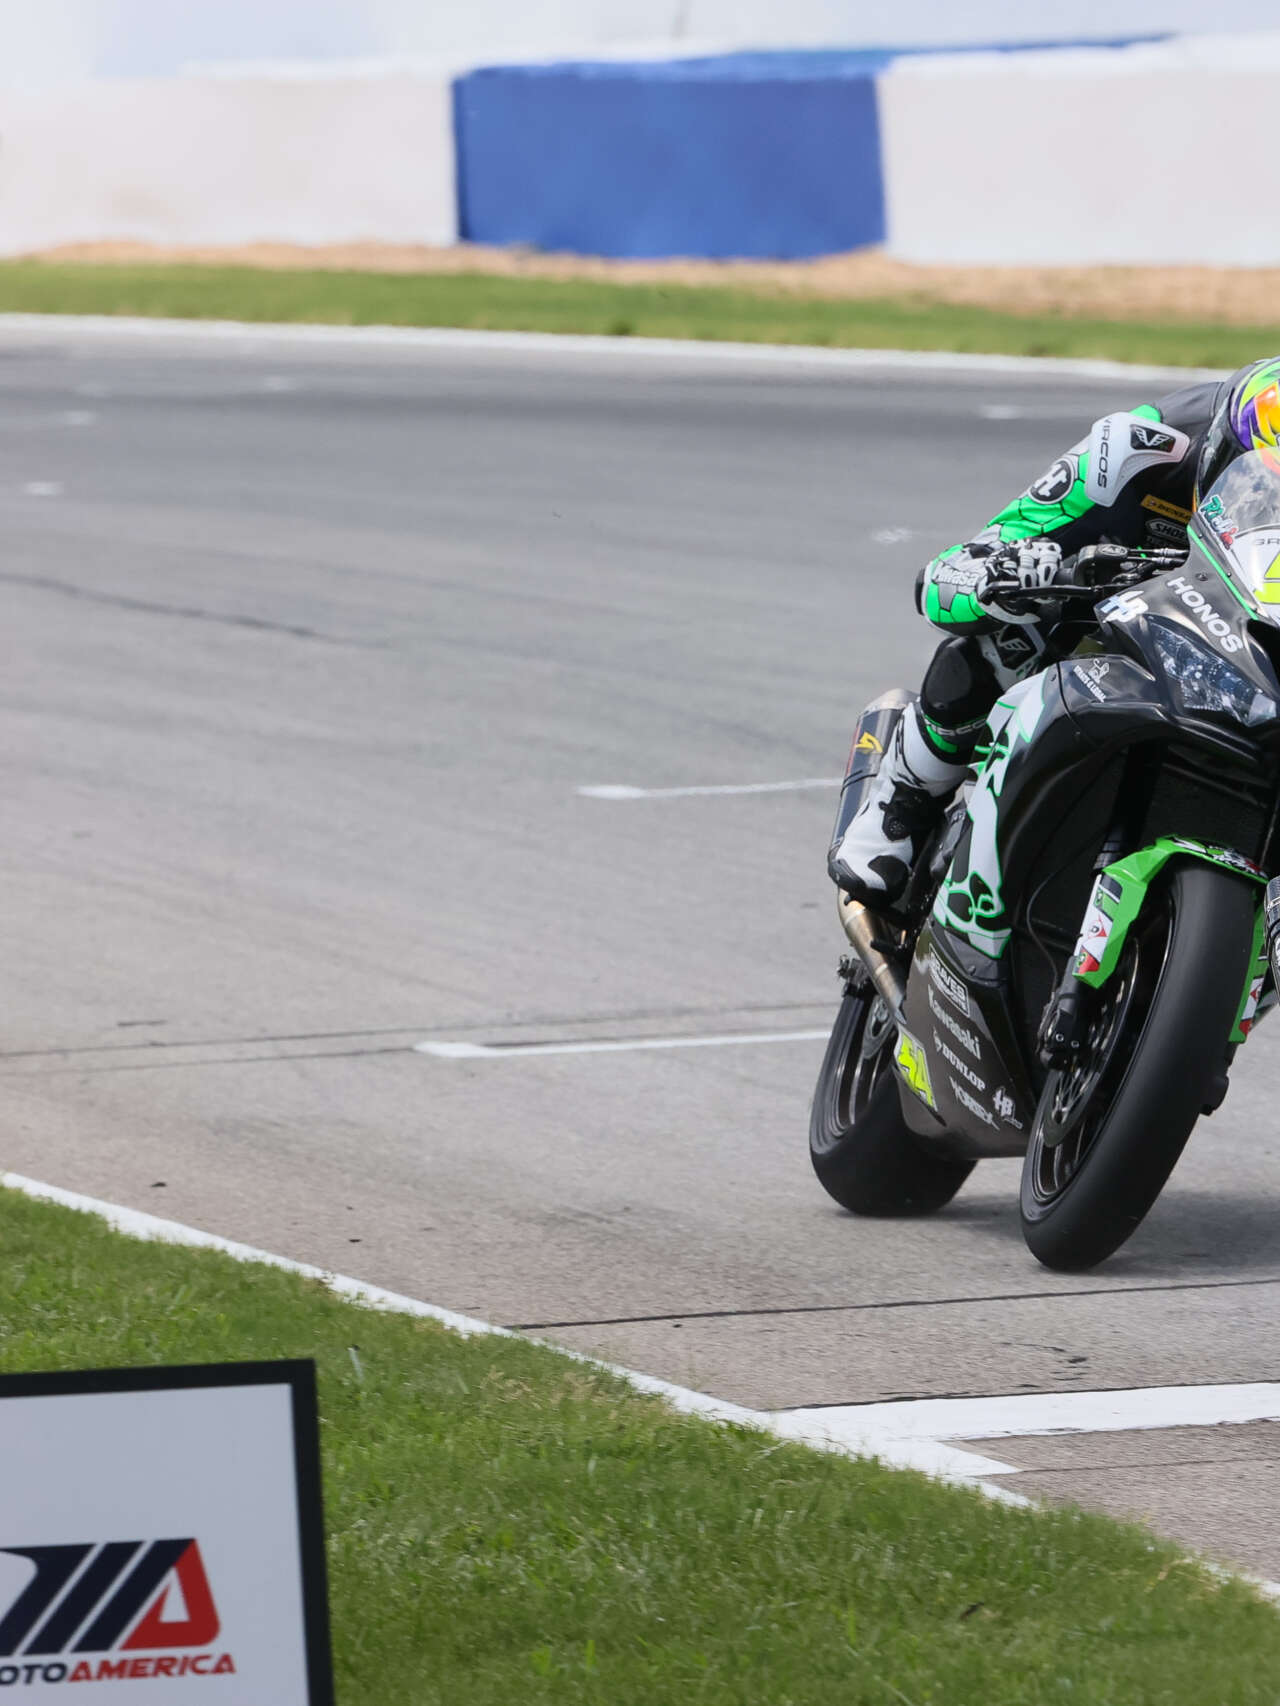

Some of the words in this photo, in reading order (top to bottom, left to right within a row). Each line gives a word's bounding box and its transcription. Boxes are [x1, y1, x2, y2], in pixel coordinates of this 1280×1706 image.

[1167, 576, 1243, 654] HONOS
[942, 1042, 986, 1092] DUNLOP
[0, 1653, 237, 1686] OTOAMERICA
